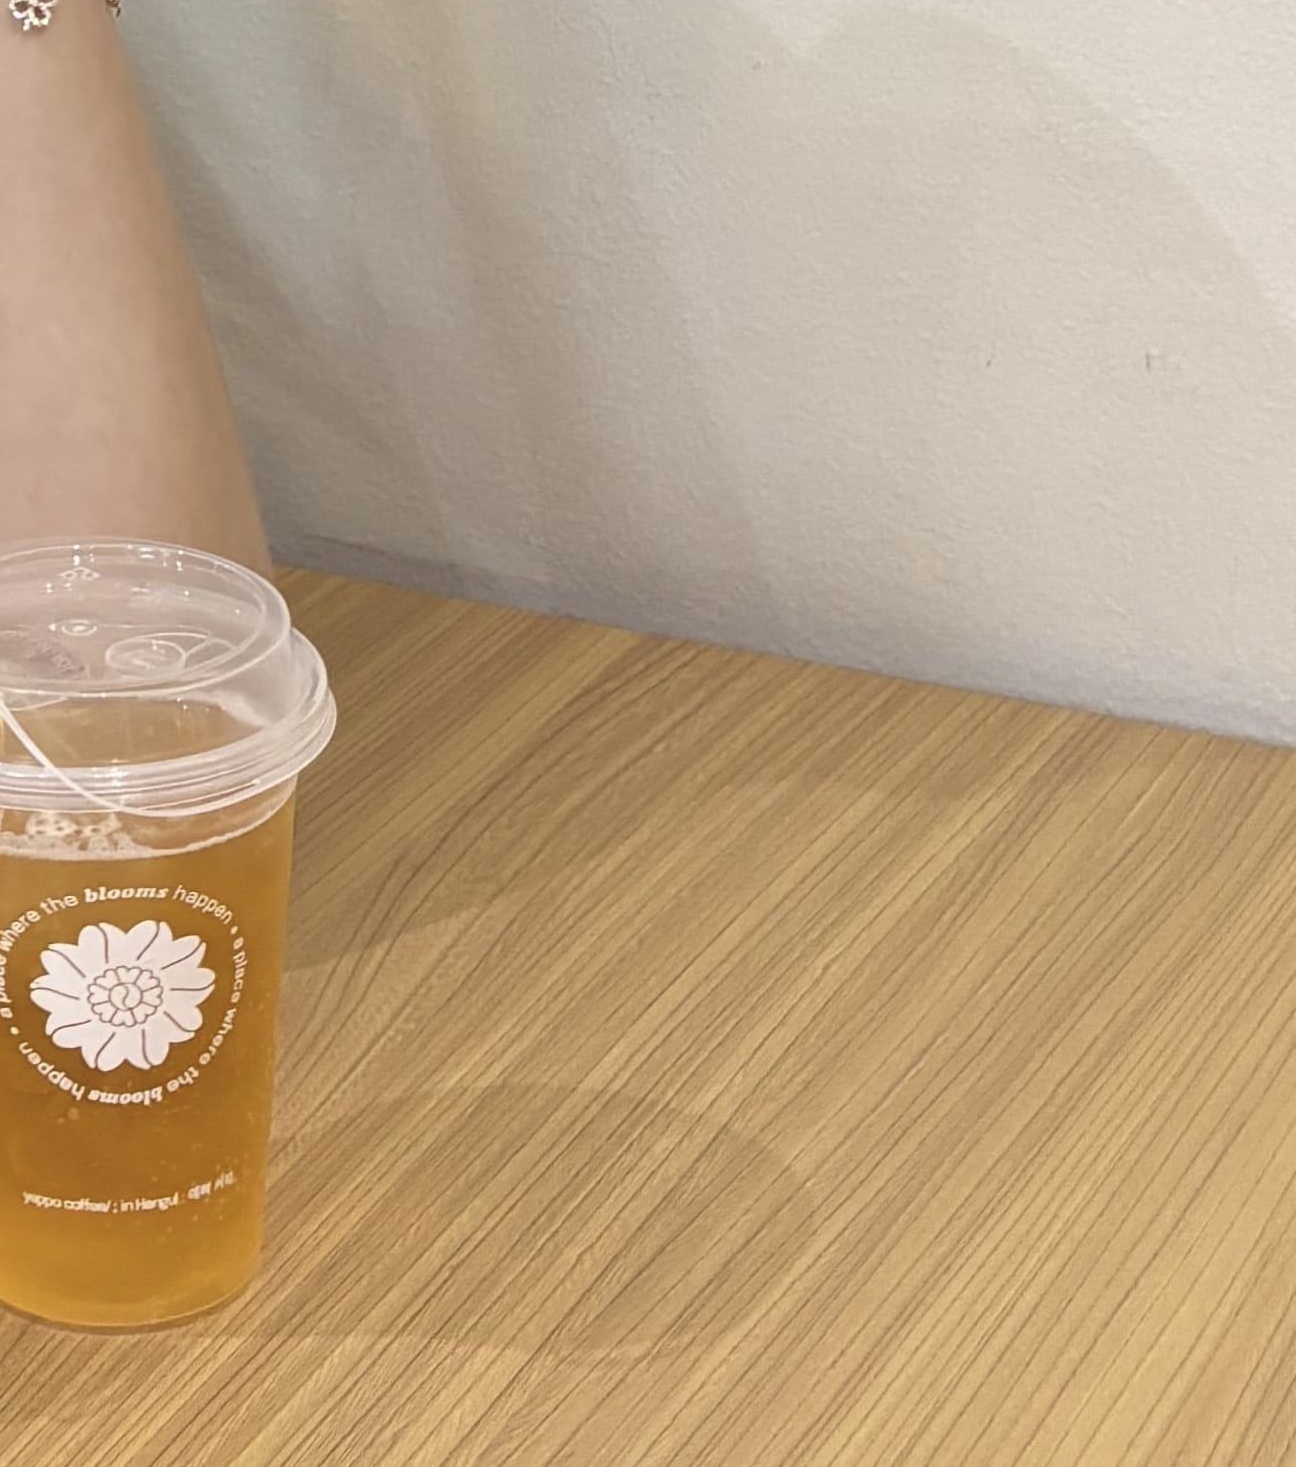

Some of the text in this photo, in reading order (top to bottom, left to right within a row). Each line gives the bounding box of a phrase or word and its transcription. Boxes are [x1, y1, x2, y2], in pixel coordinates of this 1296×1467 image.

[39, 894, 79, 915] the
[84, 885, 169, 903] blooms
[173, 884, 234, 925] happen
[231, 950, 248, 1004] place
[198, 1008, 237, 1065] where
[18, 1041, 86, 1101] happen
[166, 1066, 200, 1093] the
[87, 1085, 163, 1106] blooms
[120, 1199, 134, 1212] in
[135, 1192, 179, 1210] Hangul
